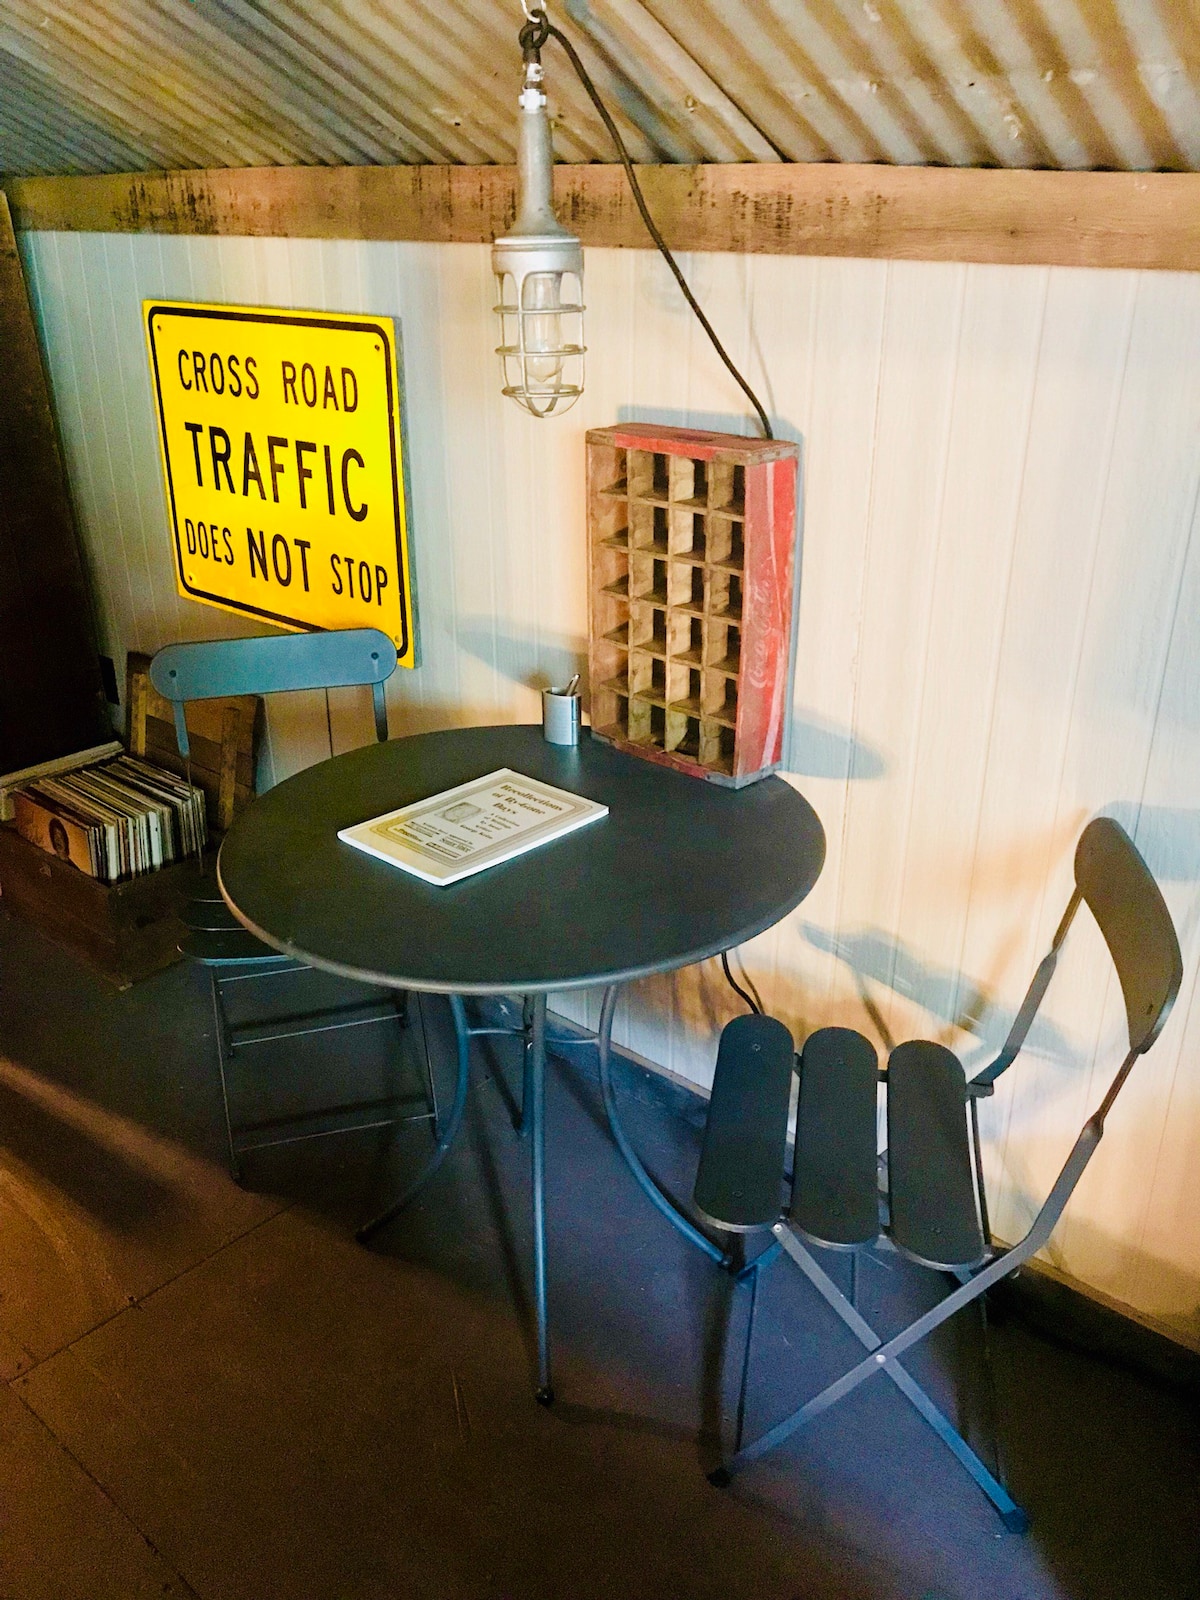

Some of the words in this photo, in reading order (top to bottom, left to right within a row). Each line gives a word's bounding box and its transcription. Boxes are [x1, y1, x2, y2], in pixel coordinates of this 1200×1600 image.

[178, 349, 259, 400] CROSS
[282, 360, 359, 413] ROAD
[184, 421, 369, 522] TRAFFIC
[184, 518, 235, 566] DOES
[246, 528, 311, 592] NOT
[330, 553, 388, 606] STOP
[500, 784, 563, 811] Recollections
